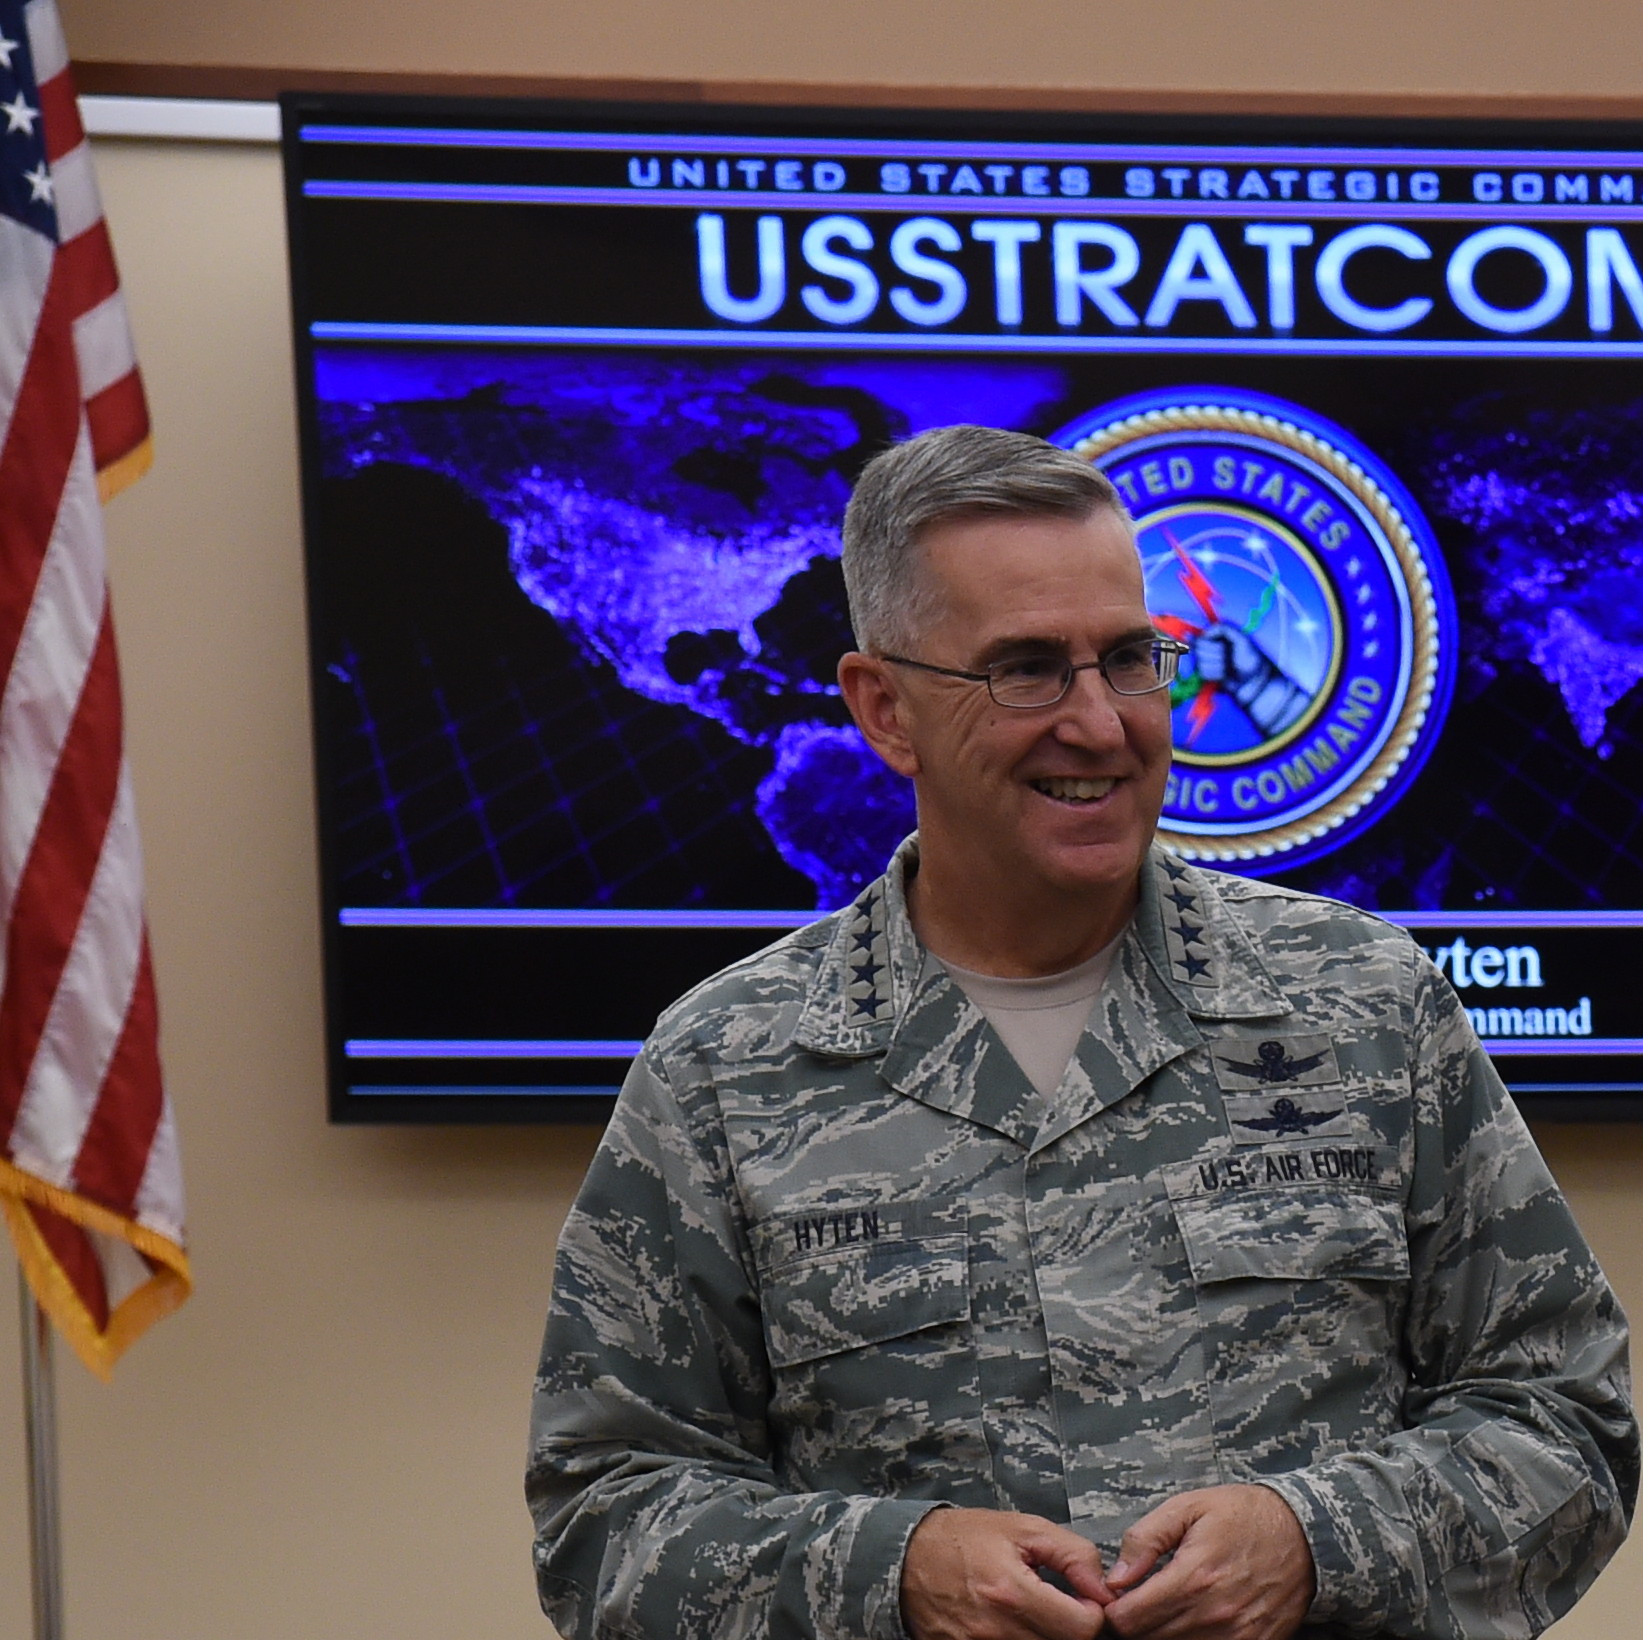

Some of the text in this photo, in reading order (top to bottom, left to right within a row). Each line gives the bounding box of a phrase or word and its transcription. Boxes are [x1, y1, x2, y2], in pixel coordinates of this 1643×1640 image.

[627, 157, 846, 192] UNITED
[880, 163, 1090, 196] STATES
[1125, 167, 1440, 201] STRATEGIC
[1114, 456, 1352, 551] TED STATES
[1231, 675, 1383, 809] COMMAND
[1265, 1154, 1304, 1183] AIR
[1311, 1149, 1378, 1180] FORCE
[794, 1210, 880, 1251] HYTEN
